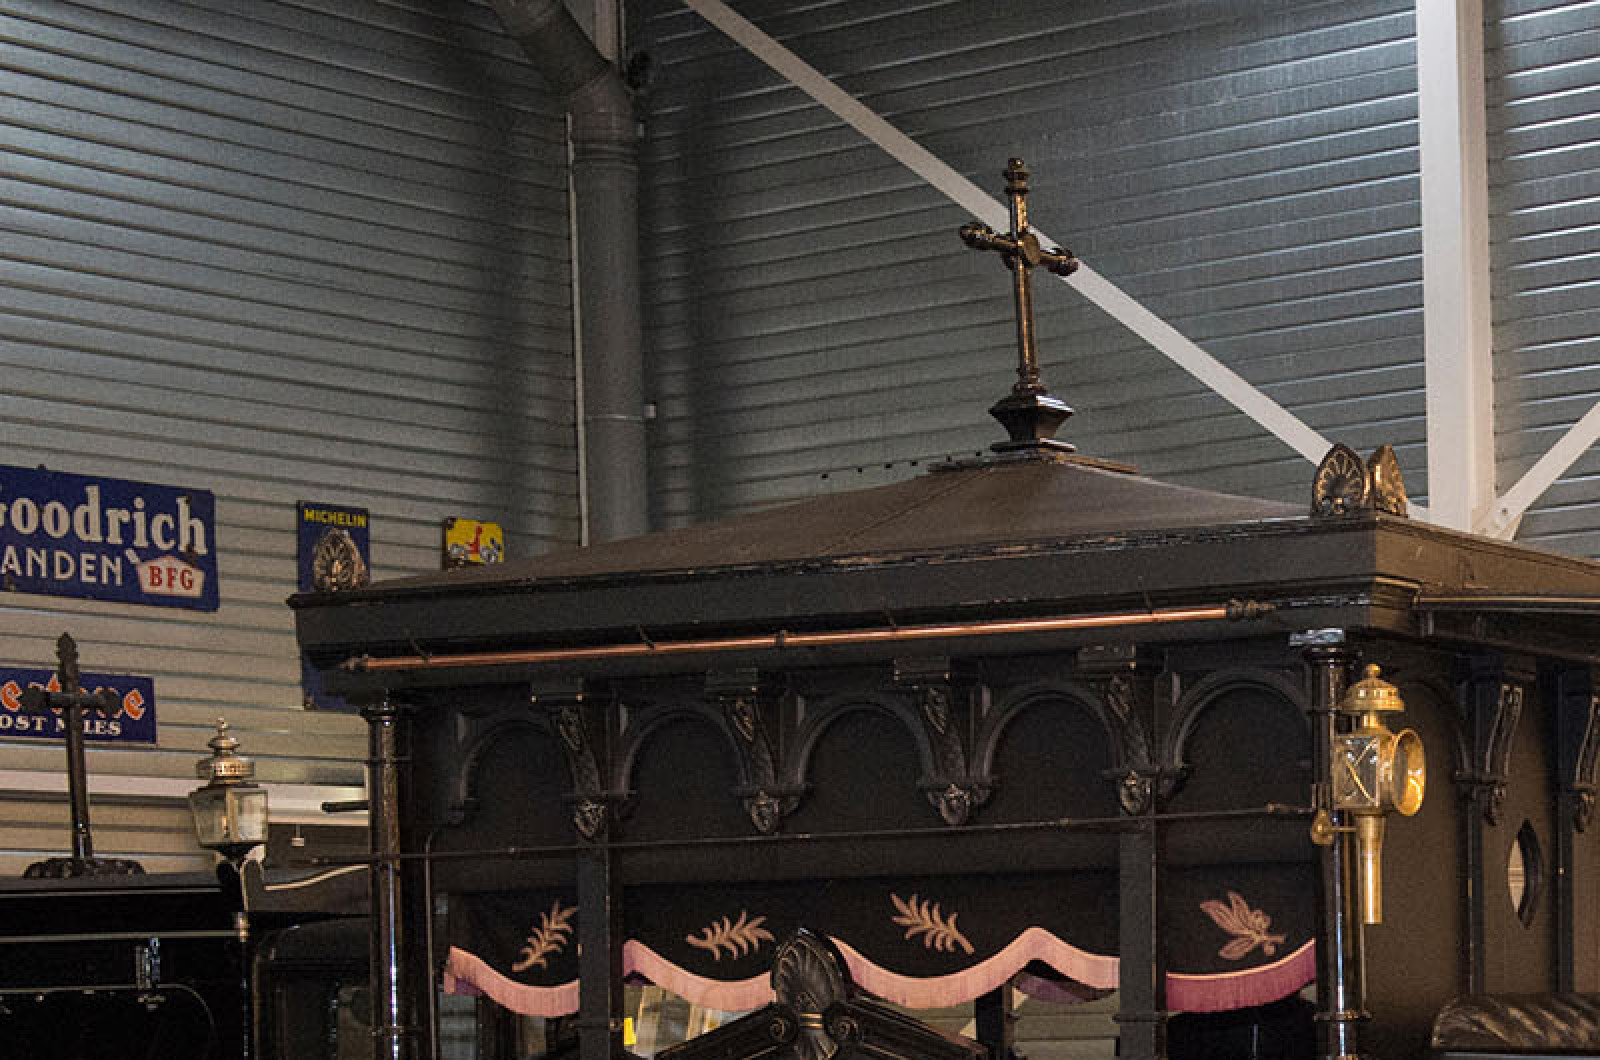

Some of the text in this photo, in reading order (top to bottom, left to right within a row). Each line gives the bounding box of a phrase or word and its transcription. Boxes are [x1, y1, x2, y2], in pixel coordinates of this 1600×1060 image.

[0, 485, 208, 555] oodrich
[304, 508, 367, 528] MICHELIN
[149, 565, 194, 590] BFG
[55, 718, 121, 735] MLES
